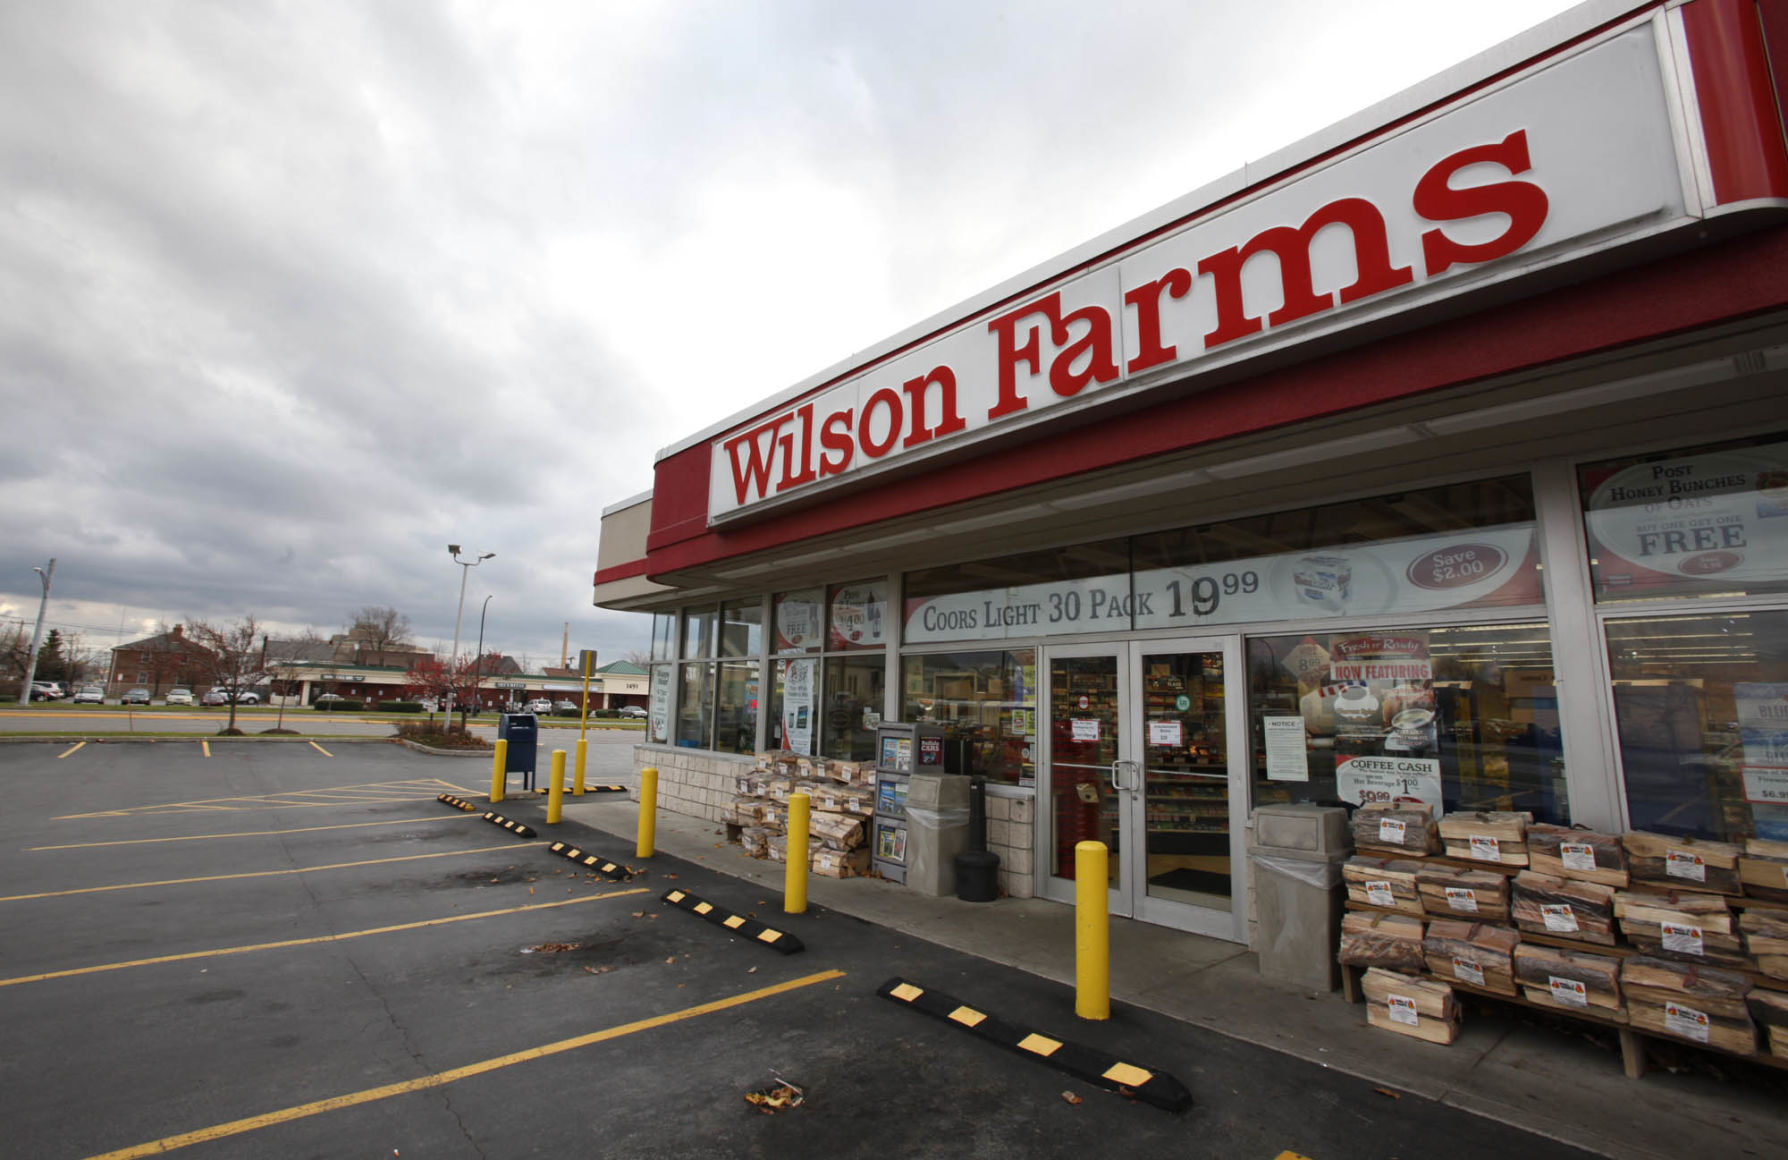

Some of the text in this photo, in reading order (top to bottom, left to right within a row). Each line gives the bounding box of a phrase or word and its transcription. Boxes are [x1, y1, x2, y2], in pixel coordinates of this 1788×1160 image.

[723, 128, 1549, 506] Wilson Farms
[1636, 523, 1748, 557] FREE
[1432, 549, 1477, 568] Save
[1432, 559, 1485, 584] $2.00
[1048, 590, 1081, 624] 30
[1339, 641, 1370, 654] Fresh
[1383, 638, 1421, 651] Ready
[1335, 663, 1429, 680] NOW FEATURING
[1271, 720, 1296, 728] NOTICE
[1350, 759, 1395, 771] COFFEE
[1397, 761, 1433, 773] CASH
